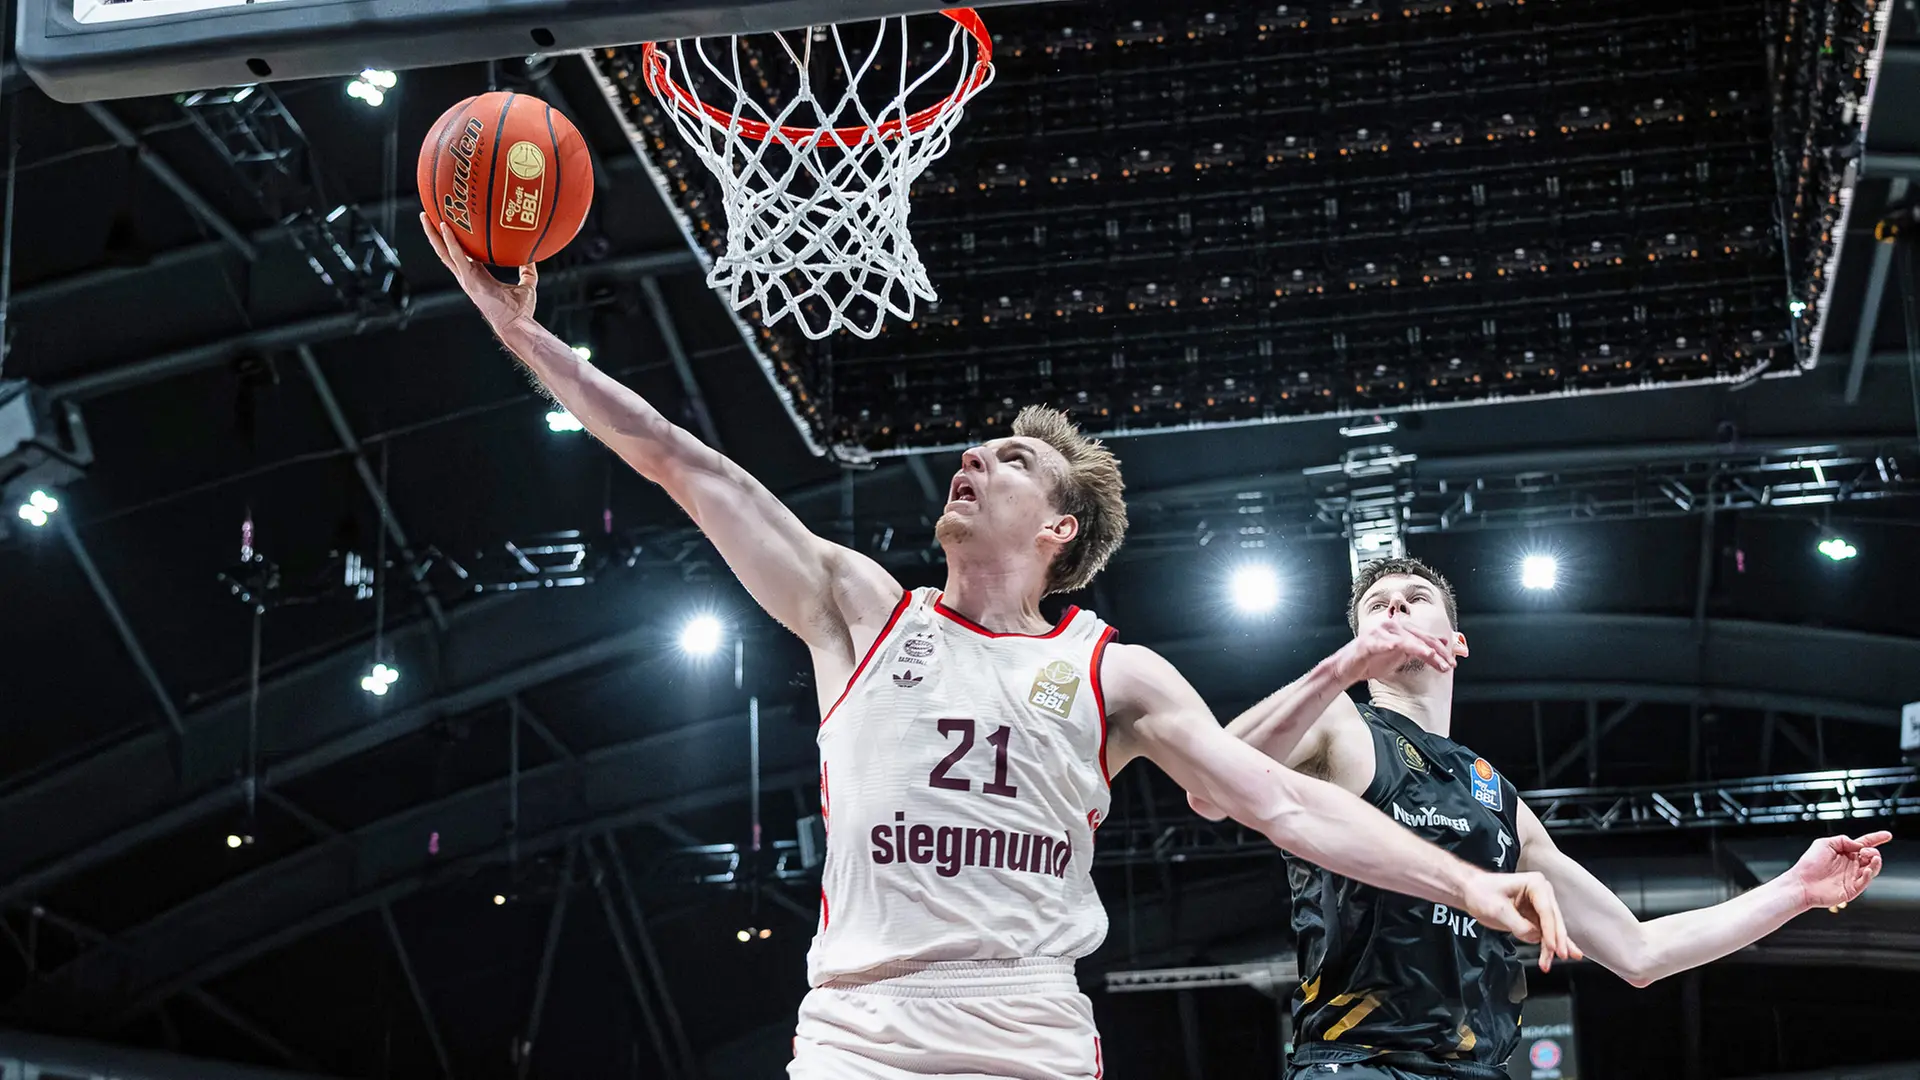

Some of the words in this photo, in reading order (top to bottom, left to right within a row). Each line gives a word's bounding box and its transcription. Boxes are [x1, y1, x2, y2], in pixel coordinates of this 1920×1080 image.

[444, 117, 484, 234] Baden
[520, 189, 539, 225] BBL
[1031, 690, 1066, 714] BBL
[929, 718, 1018, 798] 21
[1475, 790, 1498, 806] BBL
[871, 811, 1073, 879] siegmund
